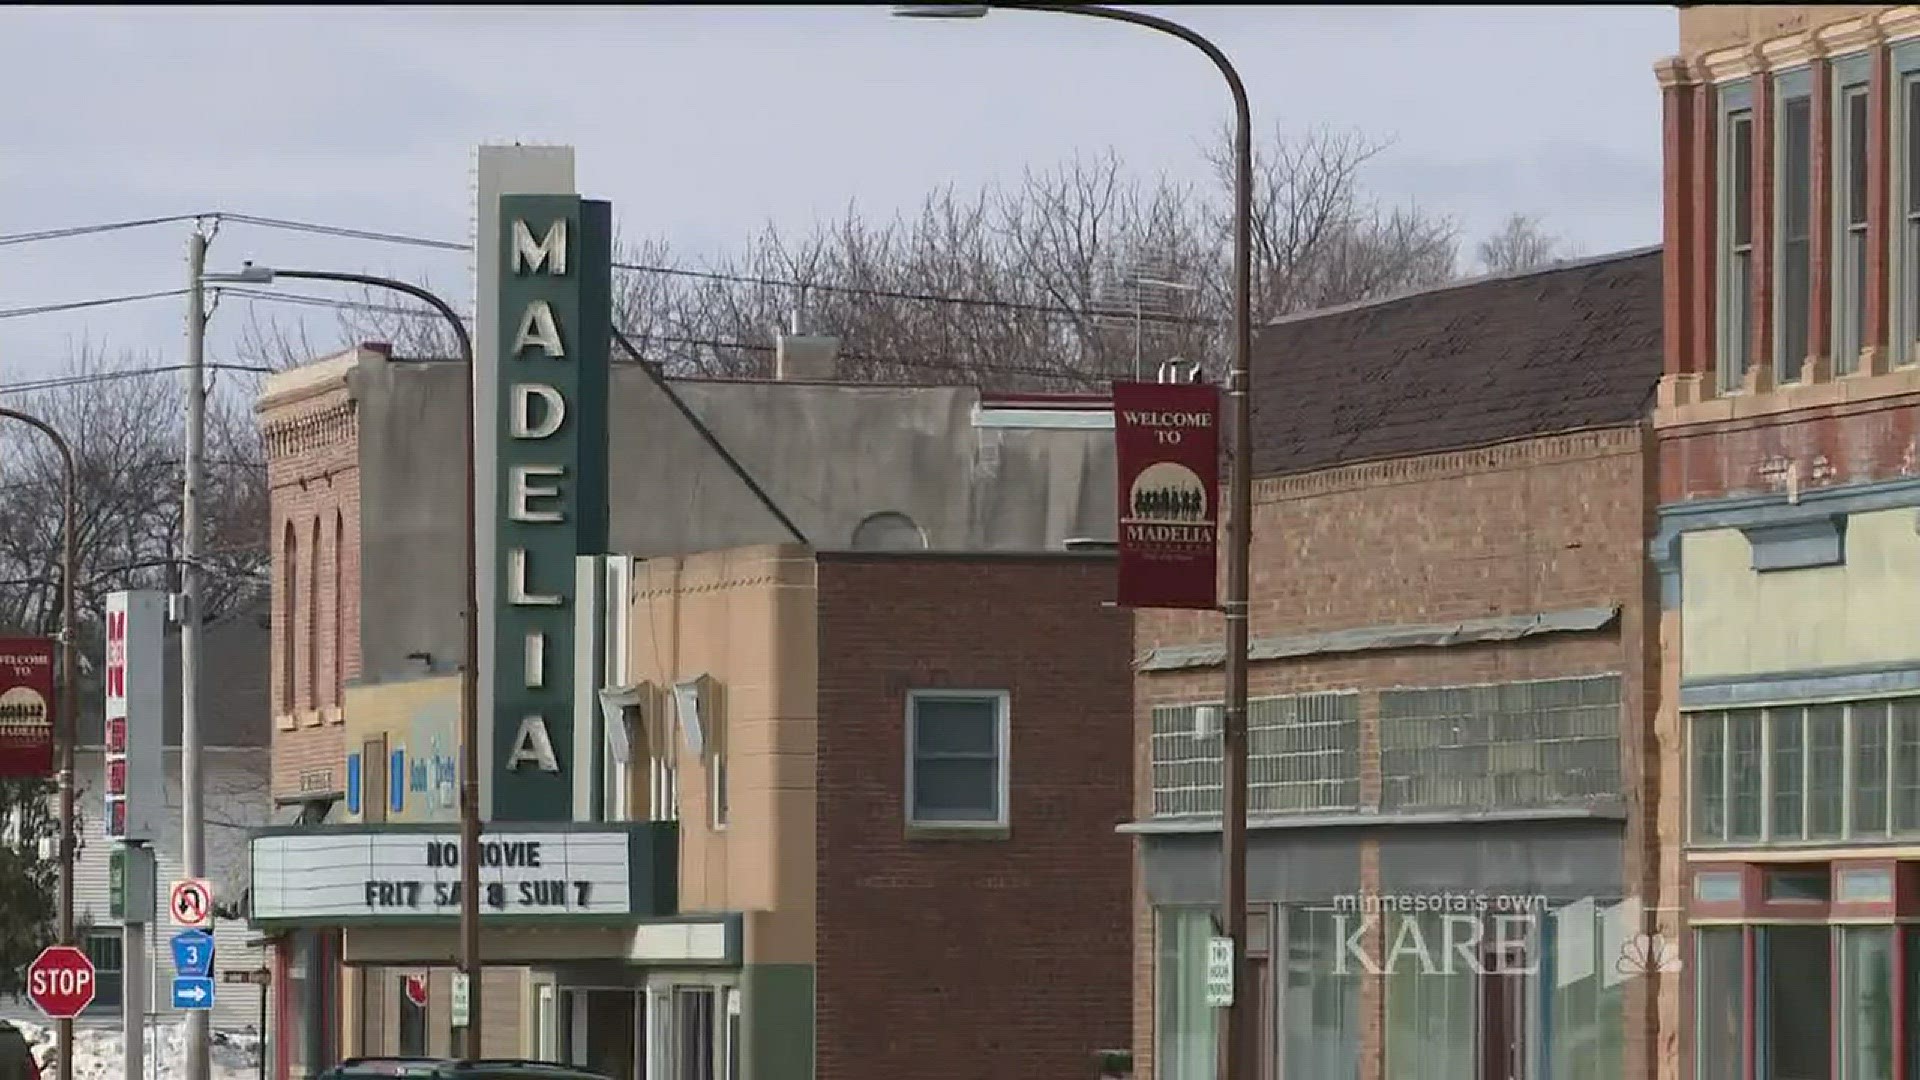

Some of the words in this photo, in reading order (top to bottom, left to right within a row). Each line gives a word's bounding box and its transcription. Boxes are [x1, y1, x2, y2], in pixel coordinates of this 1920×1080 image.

[1123, 411, 1212, 427] WELCOME
[1155, 430, 1181, 444] TO
[507, 217, 568, 773] MADELIA
[1127, 525, 1213, 542] MADELIA
[14, 666, 32, 675] TO
[426, 841, 458, 867] NO
[433, 881, 462, 906] SA
[518, 880, 566, 905] SUN
[574, 880, 592, 906] 7
[186, 946, 198, 965] 3
[33, 968, 90, 996] STOP
